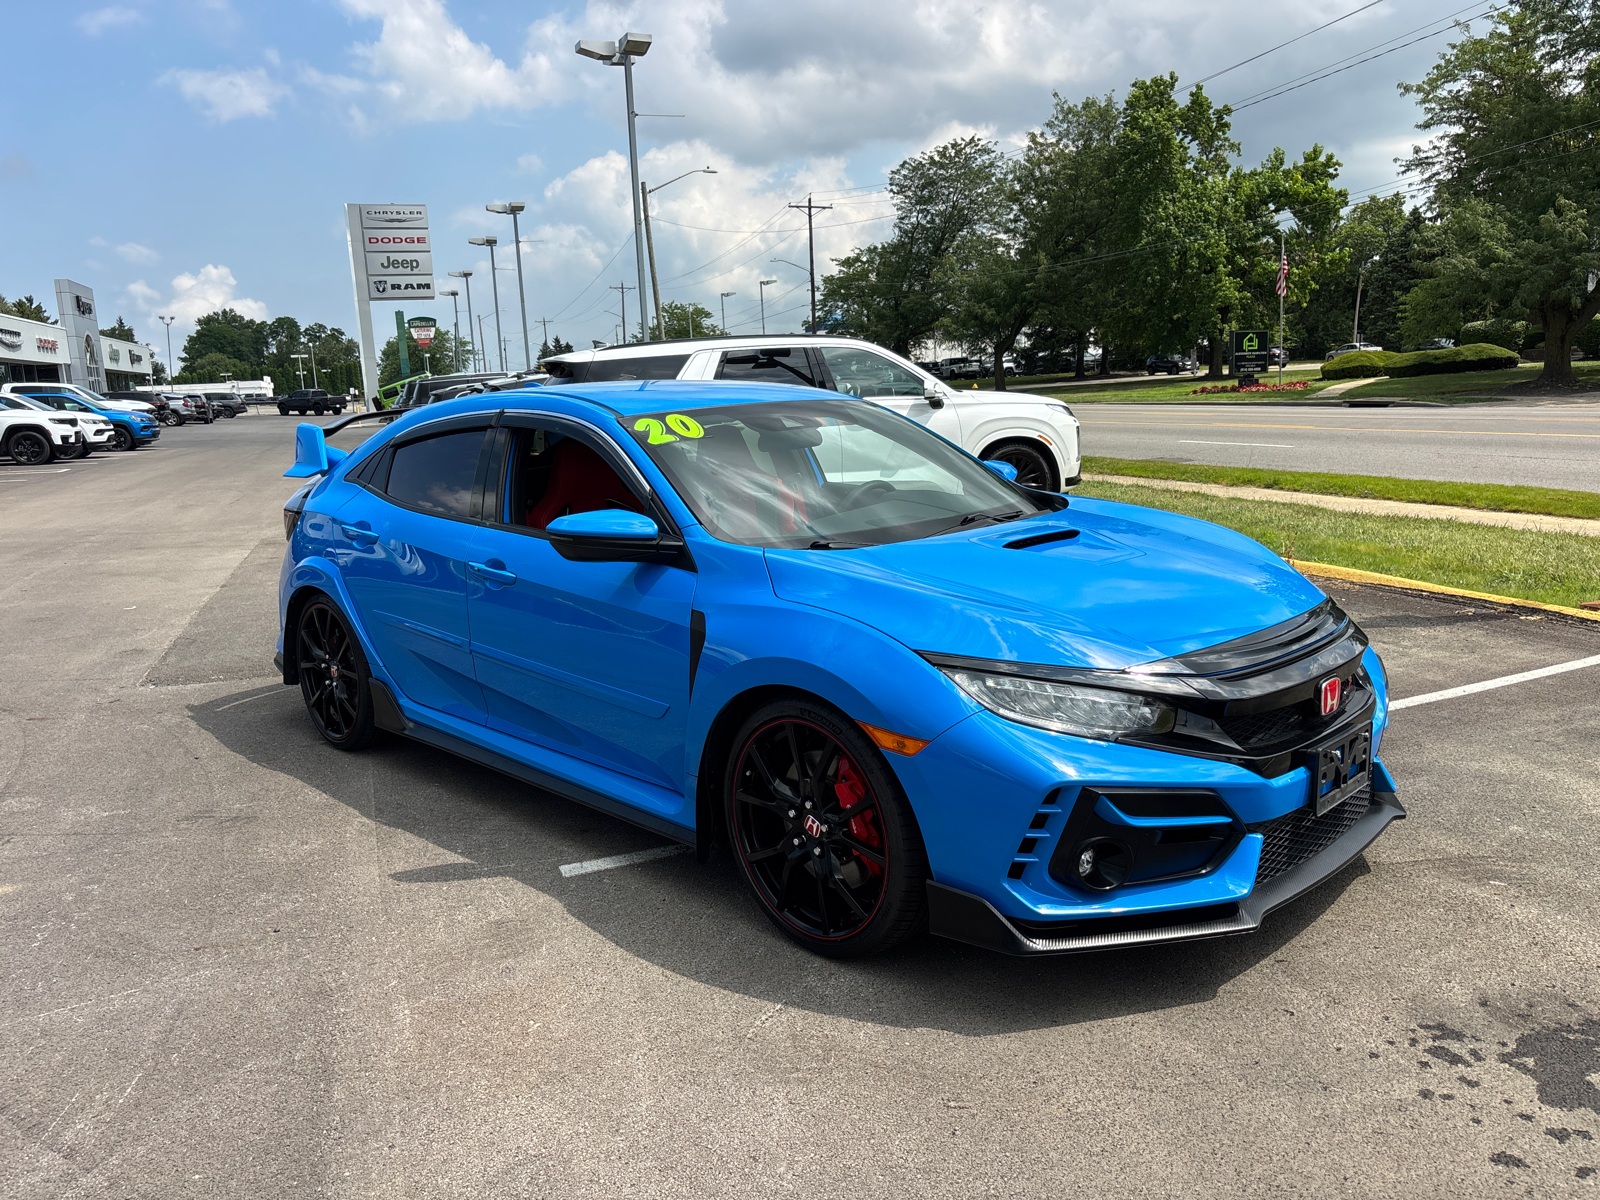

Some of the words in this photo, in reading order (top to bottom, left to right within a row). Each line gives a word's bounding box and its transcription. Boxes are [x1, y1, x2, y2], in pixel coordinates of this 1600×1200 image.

[368, 236, 427, 244] DODGE
[380, 255, 420, 272] Jeep
[390, 283, 431, 291] RAM
[634, 414, 704, 445] 20
[809, 711, 841, 734] MICHELIN
